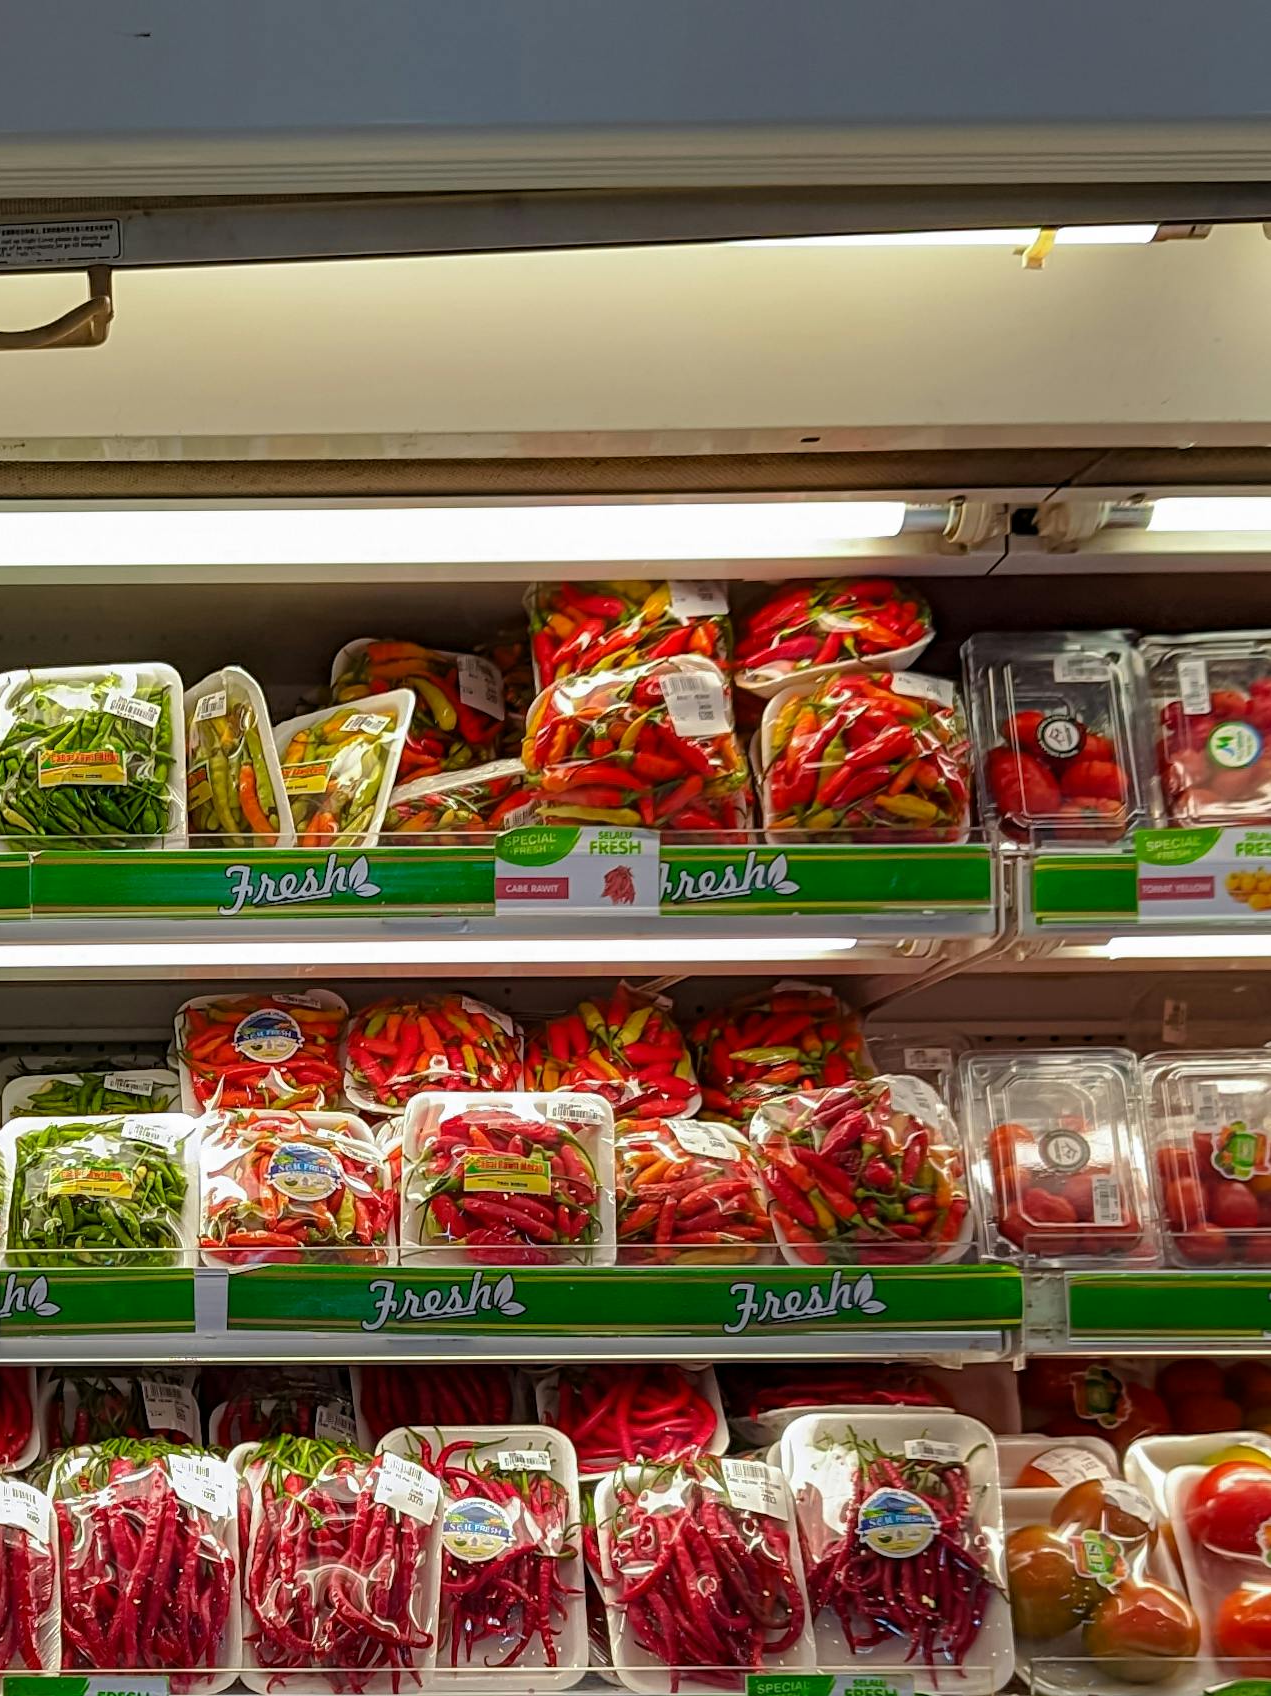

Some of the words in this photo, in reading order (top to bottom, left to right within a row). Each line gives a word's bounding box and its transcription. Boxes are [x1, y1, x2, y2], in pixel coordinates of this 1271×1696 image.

[503, 833, 557, 848] SPECIAL
[597, 831, 633, 841] SELALU
[1144, 835, 1201, 852] SPECIAL
[588, 840, 641, 855] FRESH
[219, 854, 350, 915] Fresh
[505, 883, 530, 895] CABE
[530, 883, 559, 895] RAWIT
[361, 1272, 494, 1331] Fresh
[724, 1271, 852, 1334] Fresh
[472, 1523, 502, 1536] FRESH
[756, 1682, 809, 1694] SPECIAL
[851, 1678, 887, 1688] SELALU
